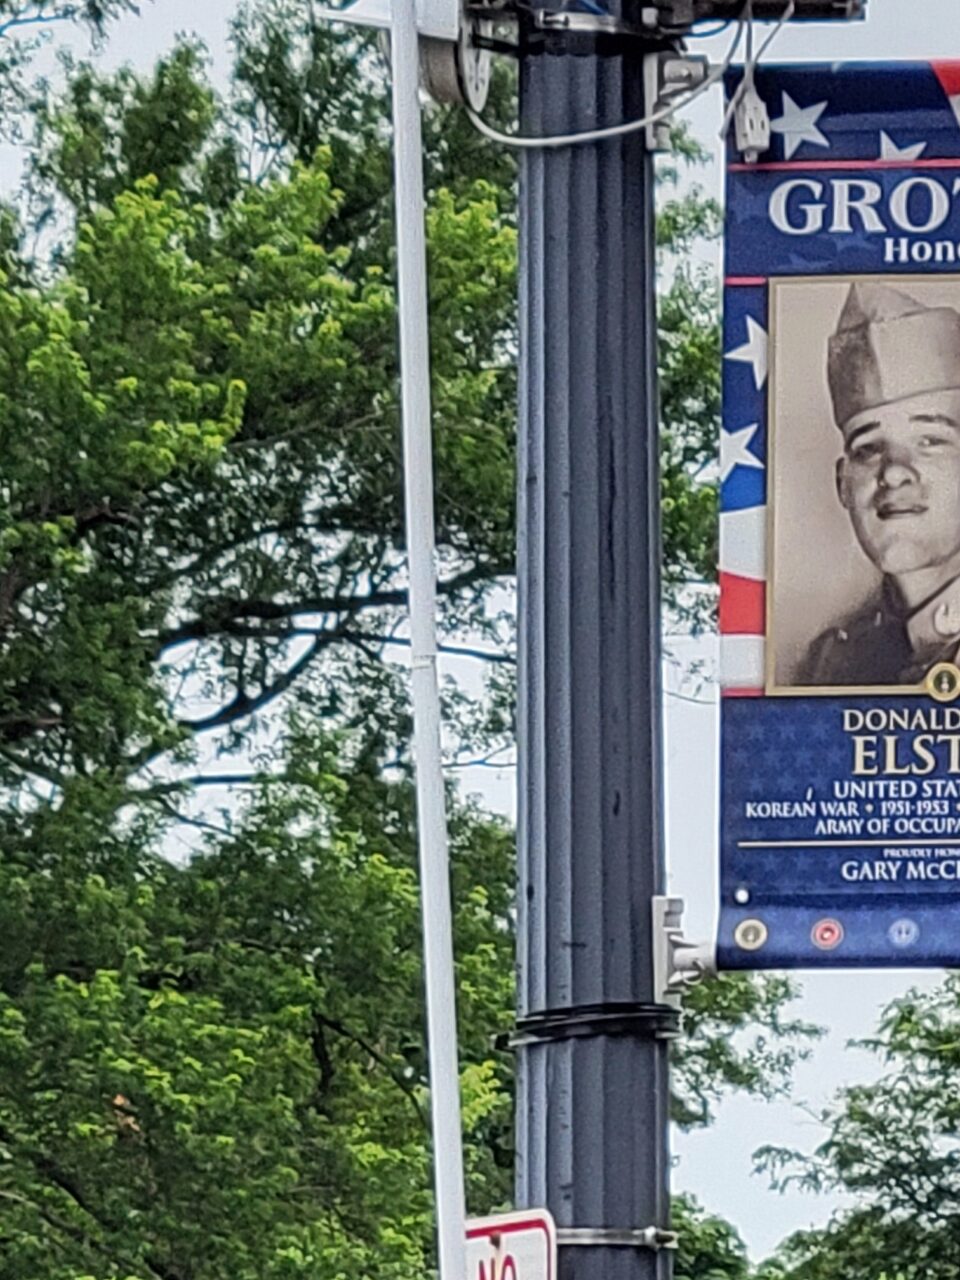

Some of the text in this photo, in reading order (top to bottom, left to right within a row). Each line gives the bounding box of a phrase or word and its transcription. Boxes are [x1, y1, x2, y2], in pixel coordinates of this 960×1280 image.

[834, 780, 917, 799] UNITED
[745, 802, 816, 818] KOREAN
[820, 801, 860, 817] WAR
[814, 819, 864, 835] ARMY
[866, 818, 891, 834] OF
[841, 862, 901, 880] GARY
